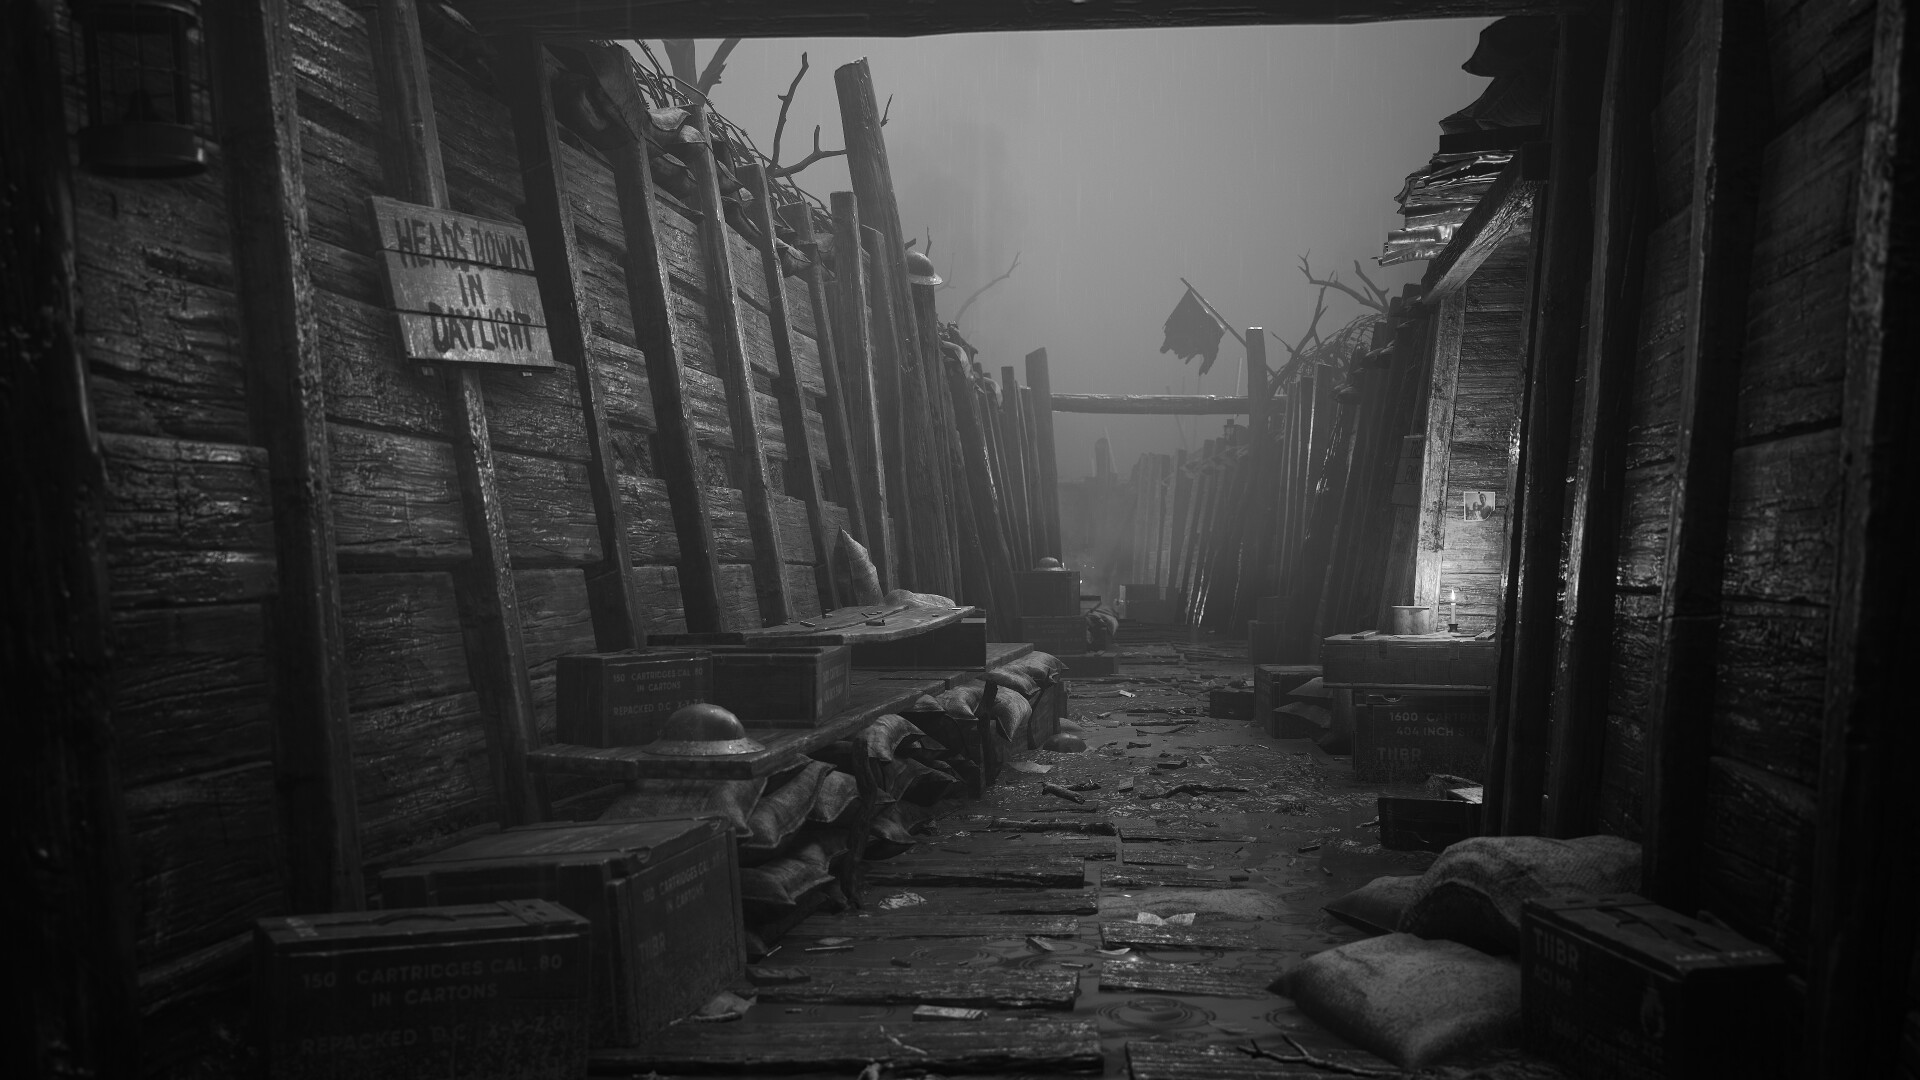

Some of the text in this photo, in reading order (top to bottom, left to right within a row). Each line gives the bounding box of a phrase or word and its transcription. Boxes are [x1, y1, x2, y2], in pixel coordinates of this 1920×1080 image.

[395, 217, 530, 273] HEADS DOWN
[458, 273, 486, 307] IN
[428, 301, 533, 353] DAYLIGHT
[612, 673, 626, 684] 150
[631, 670, 676, 682] CARTRIDGES
[636, 680, 681, 693] IN CARTONS
[613, 703, 655, 717] REPACKED
[1388, 711, 1419, 722] 1600
[1423, 726, 1454, 737] INCH
[658, 864, 698, 896] CARTRIDGES
[665, 882, 705, 915] IN CARTONS
[301, 971, 337, 990] 150
[356, 959, 485, 987] CARTRIDGES
[490, 957, 527, 975] CAL
[371, 983, 499, 1009] IN CARTONS
[301, 1029, 418, 1056] REPACKED
